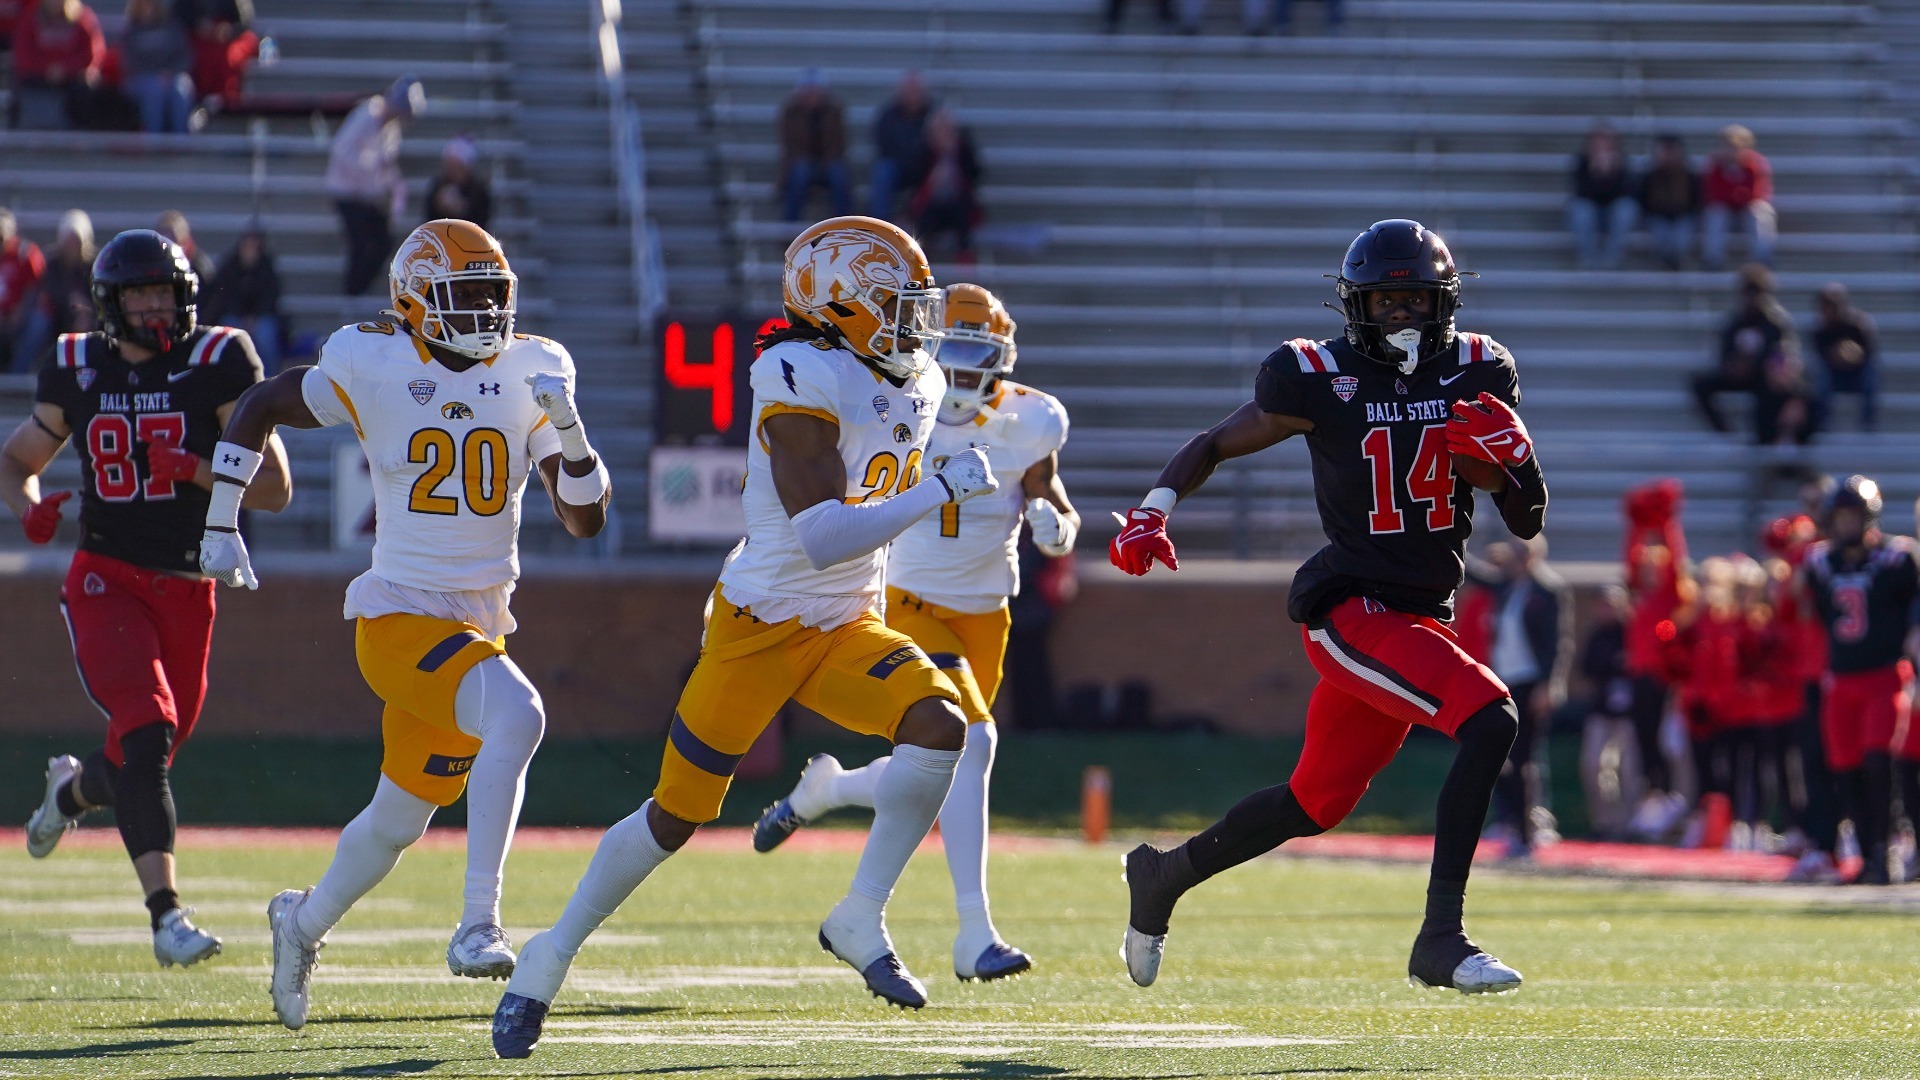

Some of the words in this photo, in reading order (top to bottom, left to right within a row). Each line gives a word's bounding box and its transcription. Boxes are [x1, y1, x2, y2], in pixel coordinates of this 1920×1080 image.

[409, 387, 436, 395] MAC
[1332, 383, 1358, 392] MAC
[100, 393, 129, 411] BALL
[133, 392, 170, 411] STATE
[1366, 402, 1402, 422] BALL
[1406, 399, 1448, 421] STATE
[86, 411, 186, 502] 87
[407, 426, 509, 517] 20
[1361, 424, 1457, 535] 14
[1833, 586, 1869, 643] 3
[447, 758, 475, 772] KEN
